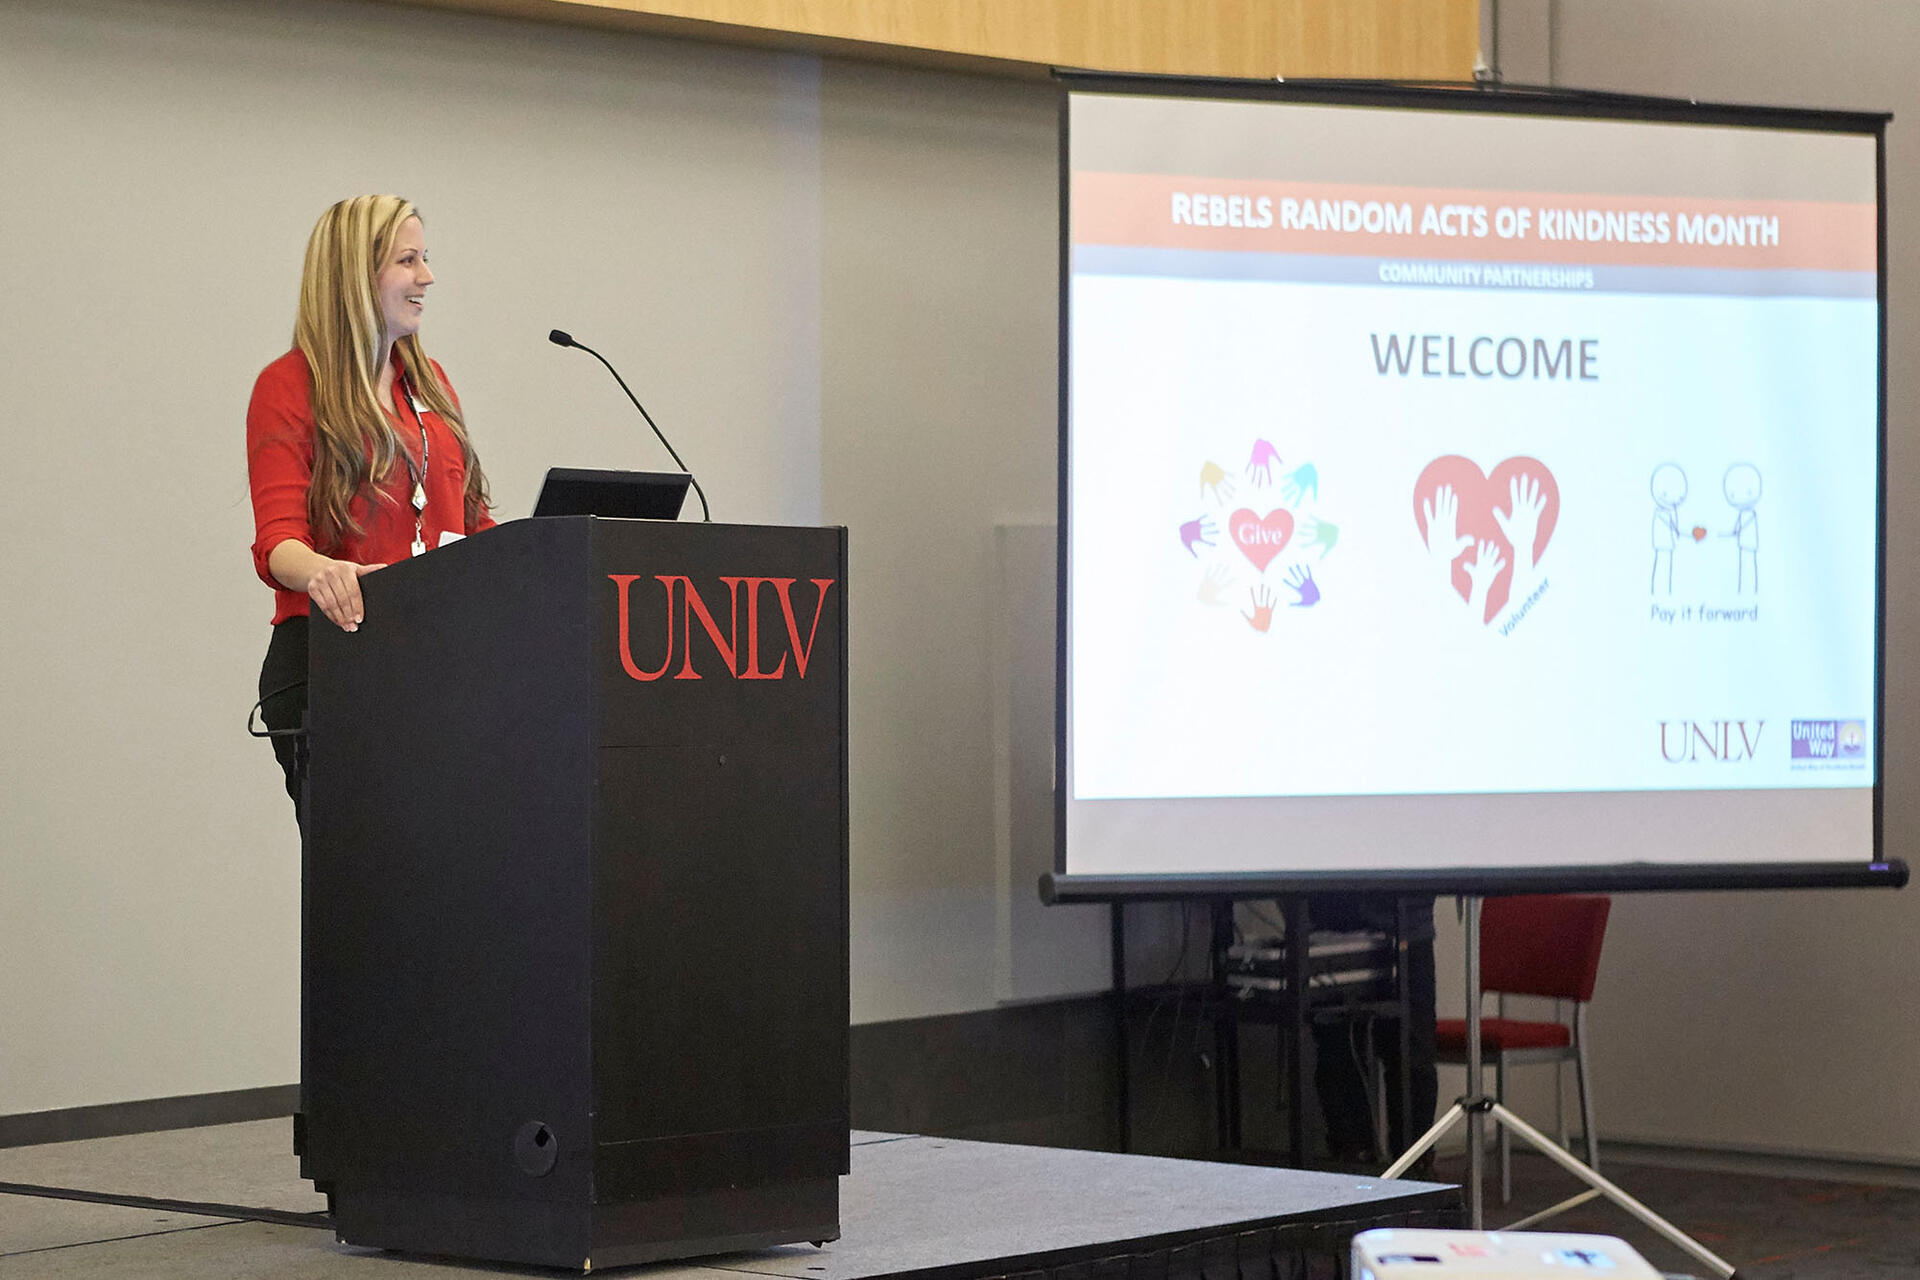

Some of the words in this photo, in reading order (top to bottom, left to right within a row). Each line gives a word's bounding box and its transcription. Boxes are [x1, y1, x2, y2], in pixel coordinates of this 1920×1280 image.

[1171, 192, 1273, 228] REBELS
[1280, 197, 1412, 234] RANDOM
[1420, 202, 1489, 238] ACTS
[1495, 207, 1531, 239] OF
[1538, 208, 1671, 244] KINDNESS
[1677, 213, 1779, 246] MONTH
[1379, 262, 1482, 285] COMMUNITY
[1483, 267, 1594, 289] PARTNERSHIPS
[1370, 333, 1599, 380] WELCOME
[1238, 522, 1283, 546] Give
[1498, 577, 1549, 637] Volunteer
[1651, 603, 1676, 626] Pay
[1681, 605, 1691, 621] it
[1699, 602, 1758, 622] forward
[607, 573, 836, 681] UNLV
[1658, 720, 1765, 763] UNLV
[1792, 721, 1835, 740] United
[1809, 739, 1835, 759] Way
